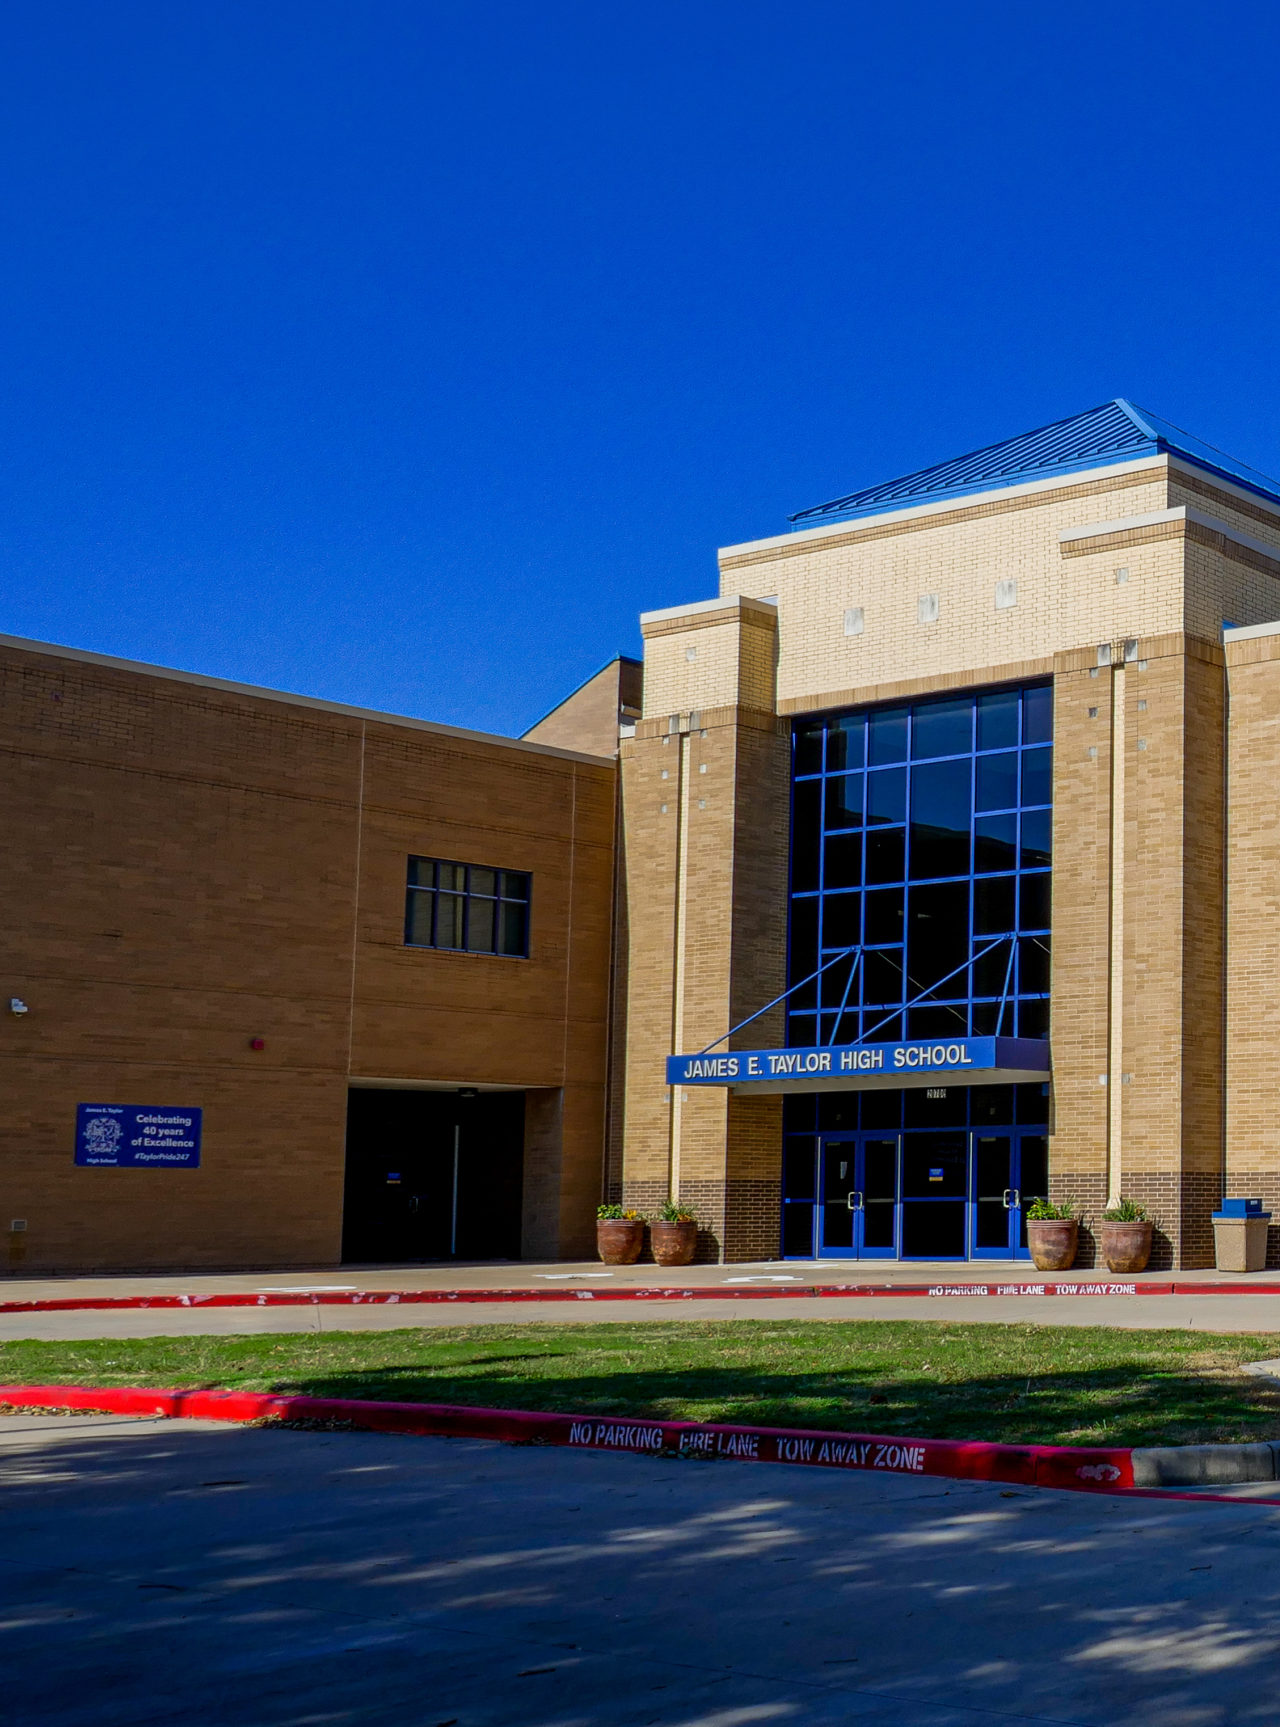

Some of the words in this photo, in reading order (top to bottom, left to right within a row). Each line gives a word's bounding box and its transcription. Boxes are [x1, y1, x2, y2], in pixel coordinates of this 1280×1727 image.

[684, 1058, 739, 1078] JAMES
[748, 1056, 763, 1075] E.
[768, 1053, 831, 1073] TAYLOR
[841, 1050, 883, 1070] HIGH
[894, 1045, 972, 1067] SCHOOL
[136, 1114, 192, 1127] Celebrating
[143, 1126, 156, 1135] 40
[158, 1128, 184, 1138] years
[131, 1137, 142, 1146] of
[144, 1138, 194, 1147] Excellence
[945, 1286, 988, 1296] PARKING
[1020, 1285, 1045, 1295] LANE
[1055, 1285, 1077, 1295] TOW
[1079, 1284, 1107, 1295] AWAY
[1109, 1284, 1136, 1295] ZONE
[569, 1422, 592, 1444] NO
[595, 1424, 663, 1449] PARKING
[679, 1432, 715, 1451] FIRE
[717, 1433, 760, 1457] LANE
[776, 1438, 815, 1461] TOW
[818, 1441, 871, 1464] AWAY
[873, 1444, 925, 1470] ZONE
